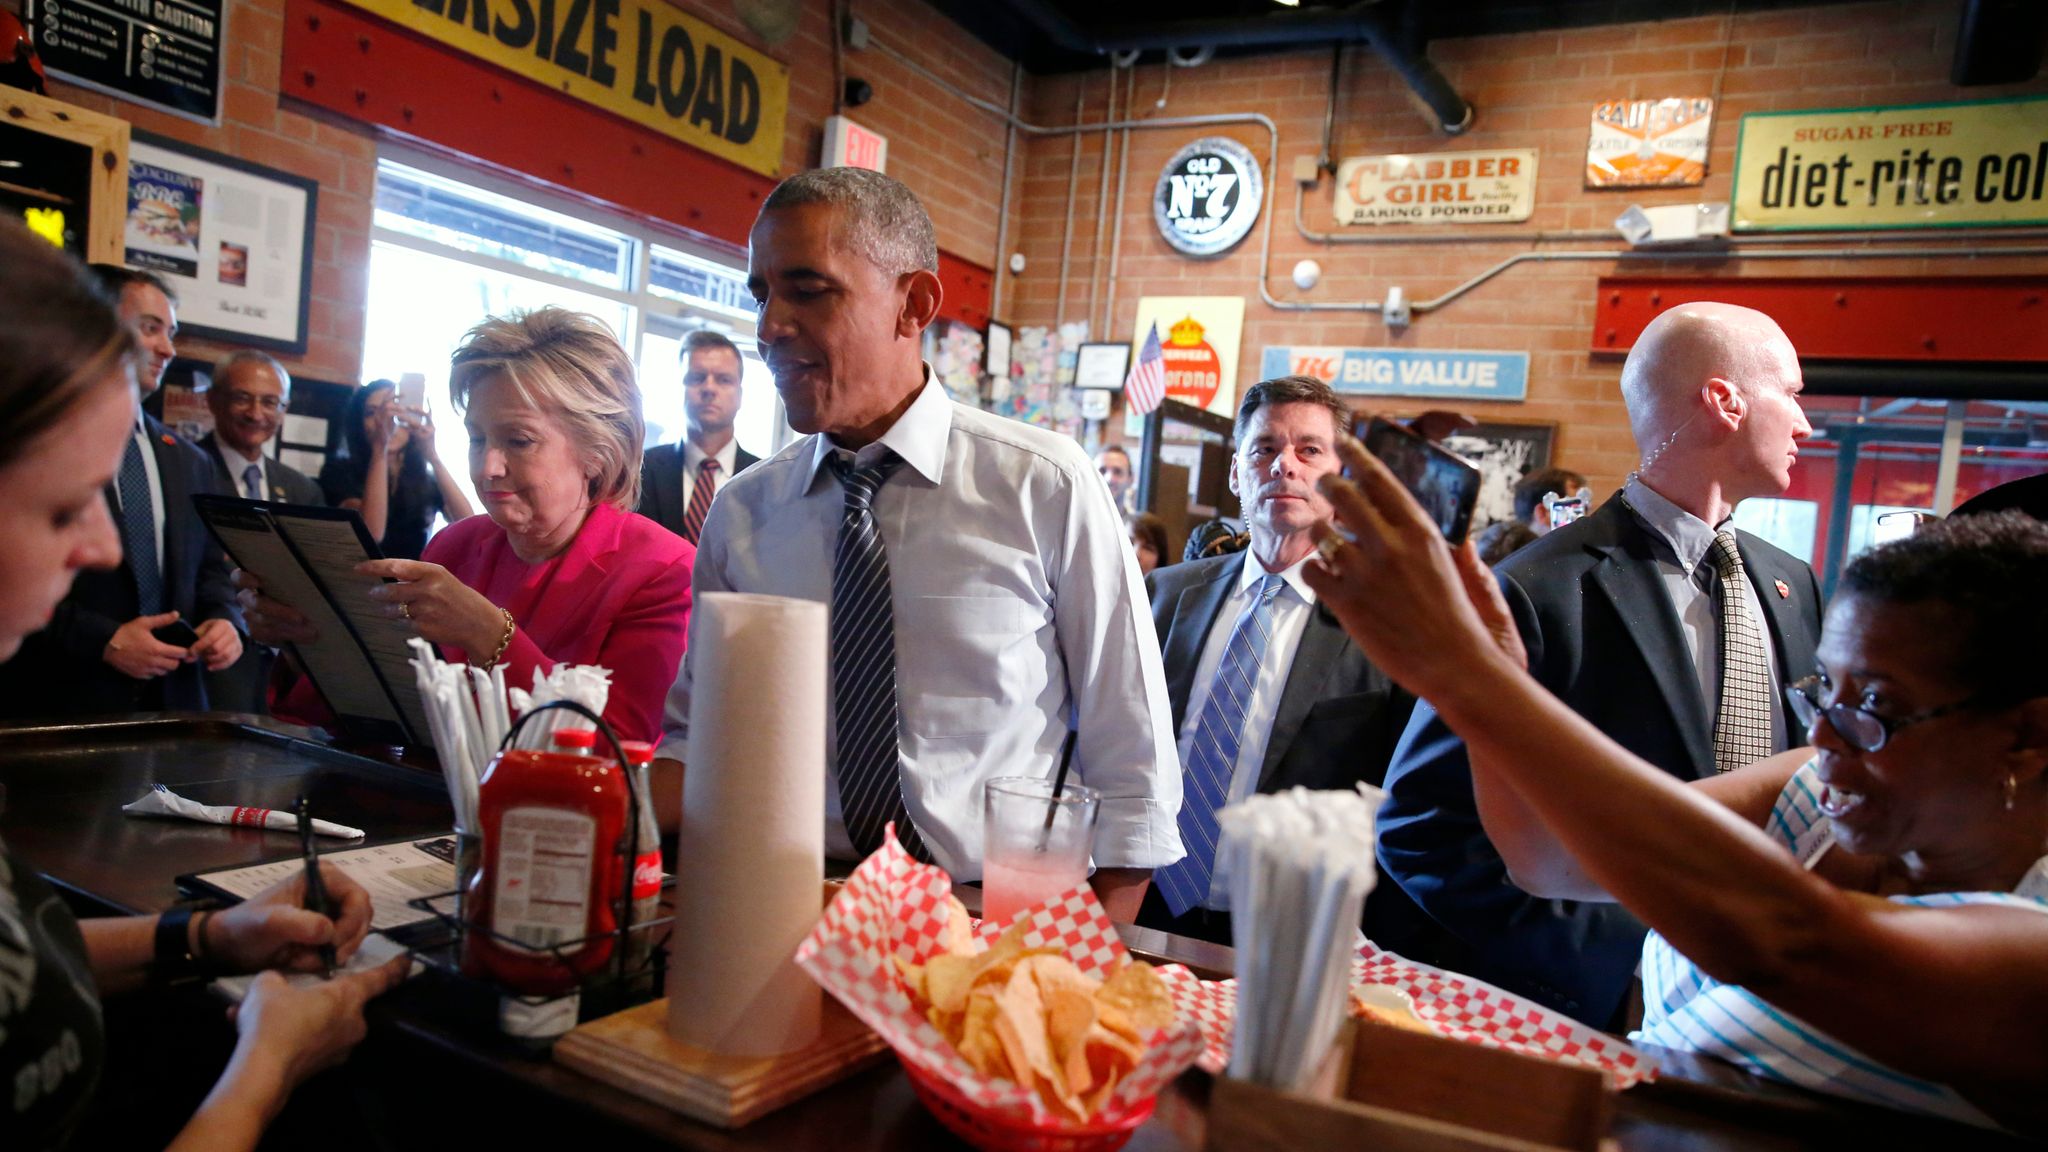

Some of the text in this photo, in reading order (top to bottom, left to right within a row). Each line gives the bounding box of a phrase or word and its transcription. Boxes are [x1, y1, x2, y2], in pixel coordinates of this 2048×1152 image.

[154, 1, 214, 40] CAUTION
[412, 0, 760, 145] SIZE LOAD
[1794, 121, 1953, 142] SUGAR FREE
[845, 123, 881, 170] EXIT
[1187, 157, 1222, 174] OLD
[1761, 147, 1962, 208] diet-rite
[1347, 157, 1520, 206] CLABBER
[1385, 182, 1475, 204] GIRL
[1354, 204, 1510, 219] BAKING POWDER
[1164, 371, 1217, 389] orona
[1343, 358, 1394, 384] BIG
[1398, 360, 1498, 387] VALUE
